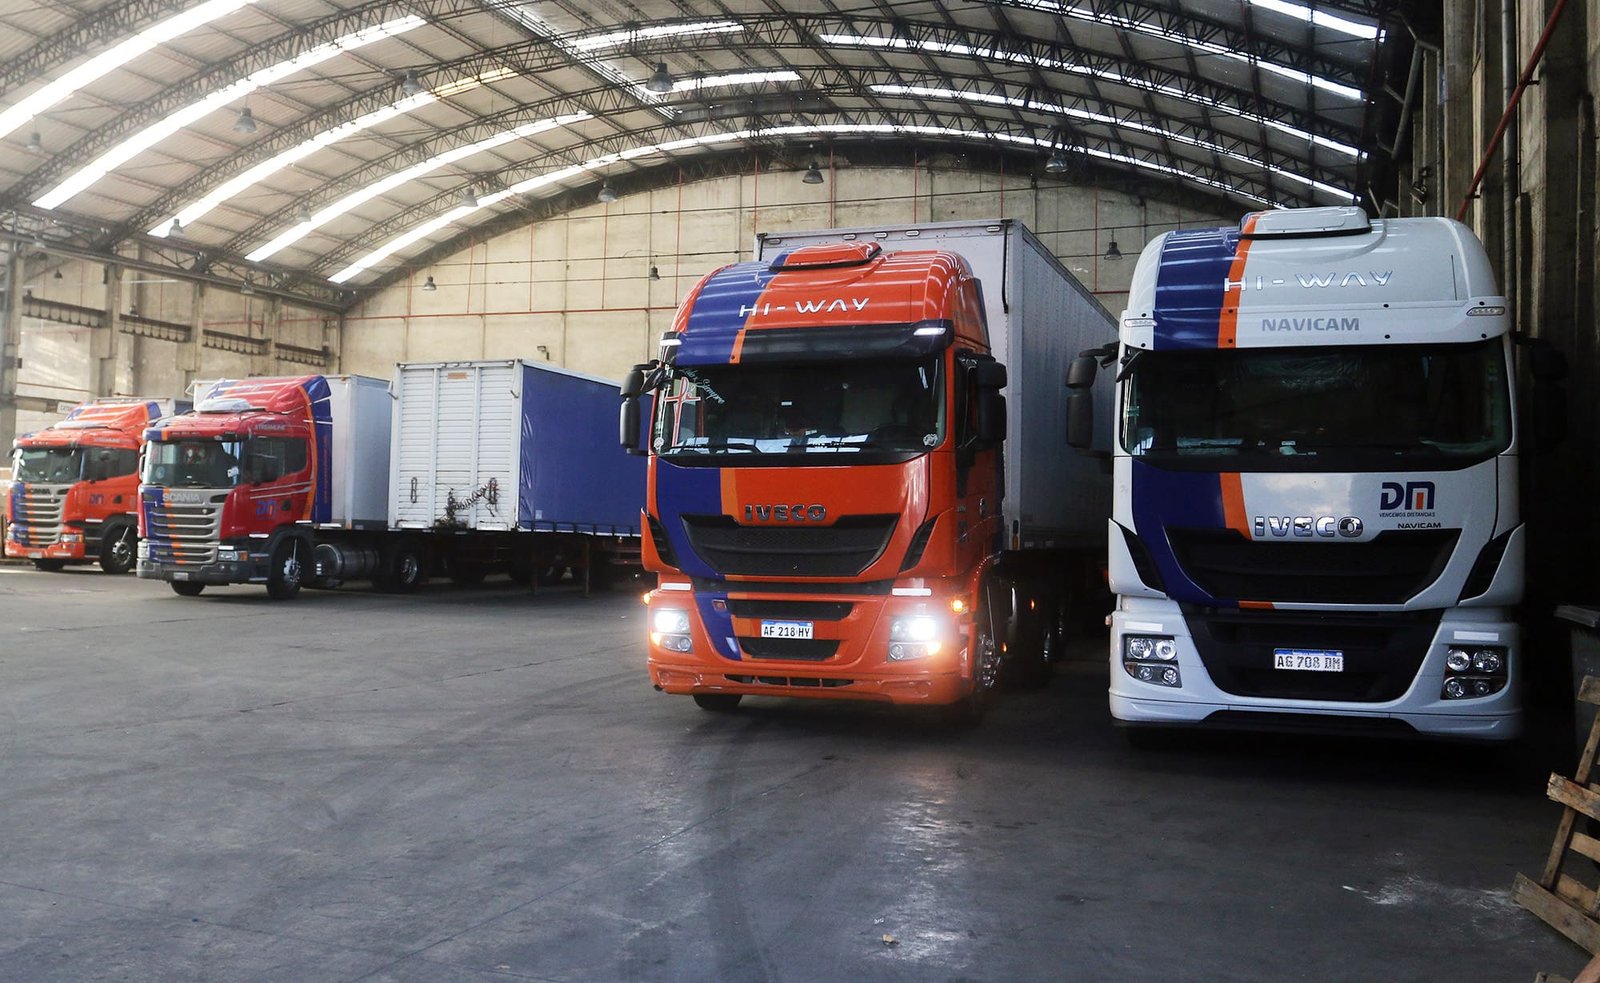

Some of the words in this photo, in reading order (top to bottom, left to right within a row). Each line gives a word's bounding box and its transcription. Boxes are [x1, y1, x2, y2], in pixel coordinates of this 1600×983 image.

[1223, 269, 1393, 292] HI-WAY
[738, 297, 870, 318] HI-WAY
[1261, 317, 1360, 332] NAVICAM
[162, 492, 202, 503] SCANIA
[745, 503, 827, 521] IVECO
[1254, 515, 1364, 538] IVECO
[763, 626, 775, 636] AF
[778, 626, 796, 637] 218
[798, 627, 810, 637] HY
[1277, 655, 1293, 668] AG
[1296, 655, 1320, 669] 708
